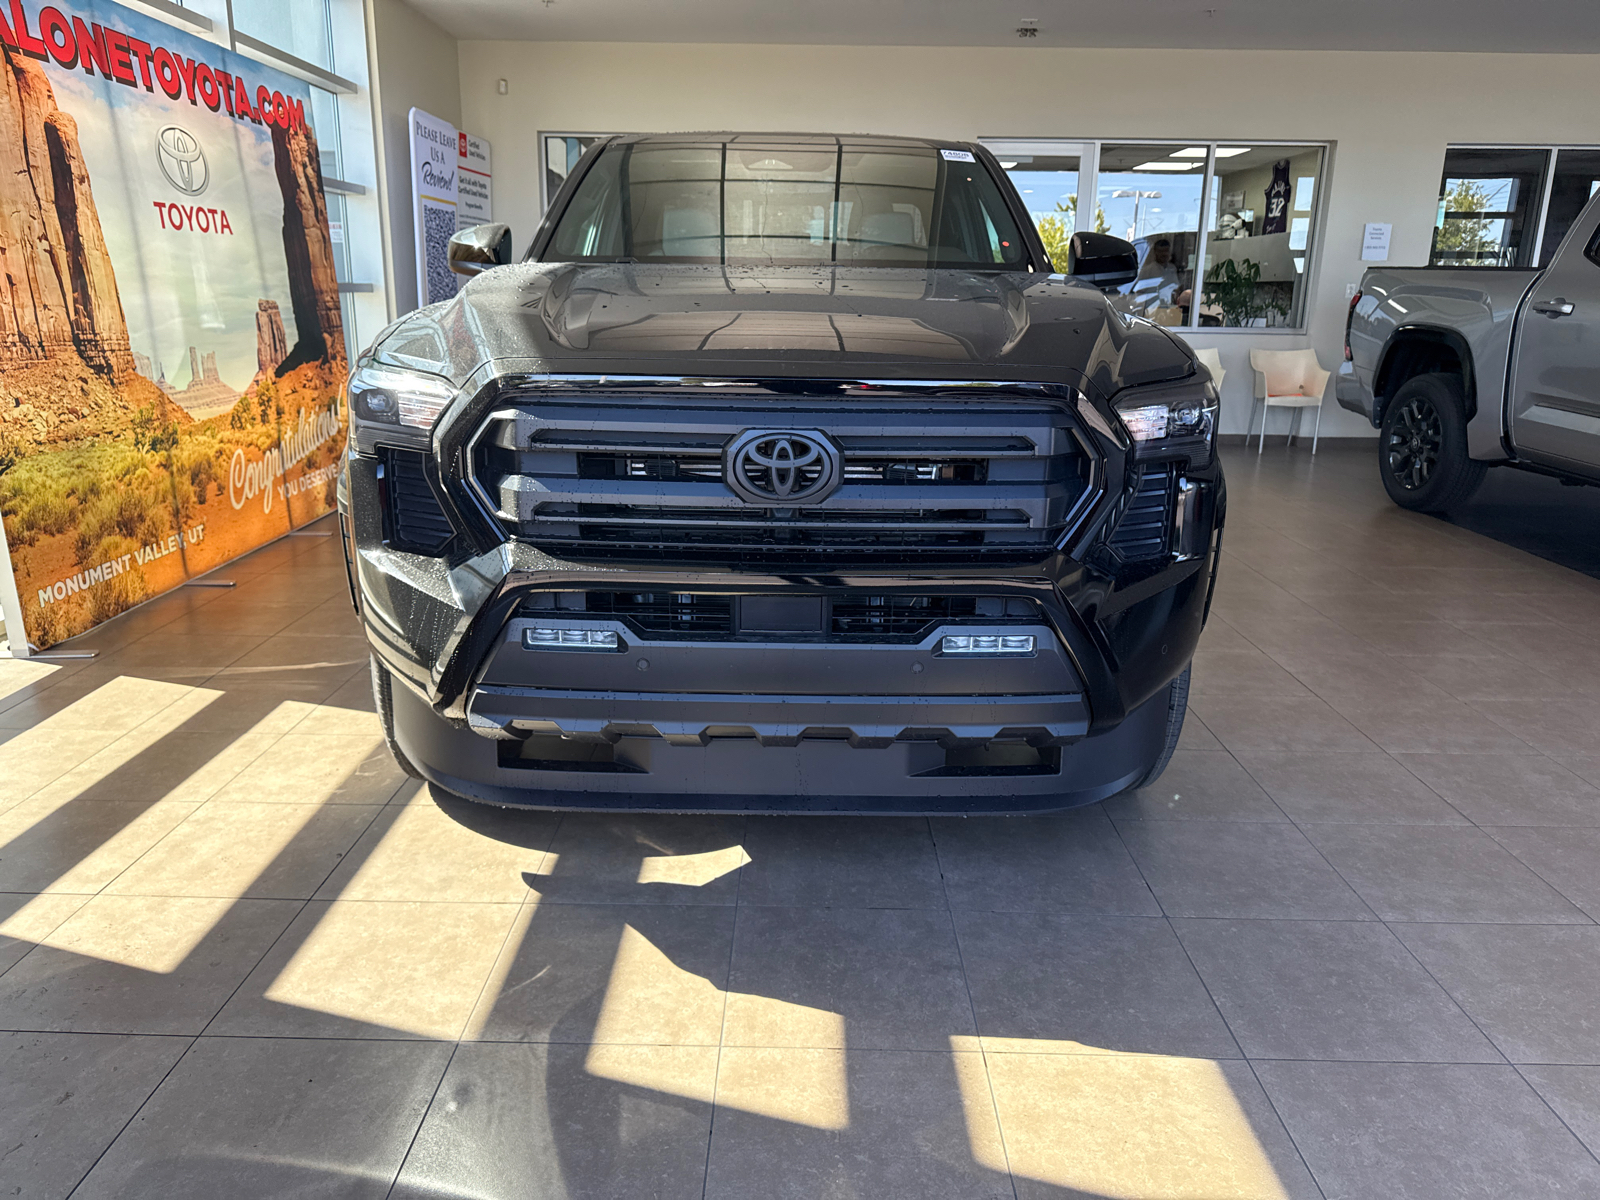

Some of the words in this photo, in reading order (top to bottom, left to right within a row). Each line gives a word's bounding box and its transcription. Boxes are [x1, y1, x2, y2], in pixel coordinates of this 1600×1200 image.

[416, 121, 438, 143] PLEASE
[439, 131, 457, 150] LEAVE
[430, 146, 439, 163] US
[440, 151, 446, 165] A
[421, 161, 455, 192] Review!
[152, 200, 234, 236] TOYOTA
[1268, 197, 1285, 218] 32
[277, 481, 299, 501] YOU
[299, 463, 339, 492] DESERVE
[37, 553, 132, 608] MONUMENT
[133, 532, 187, 567] VALLEY,
[188, 524, 205, 545] UT
